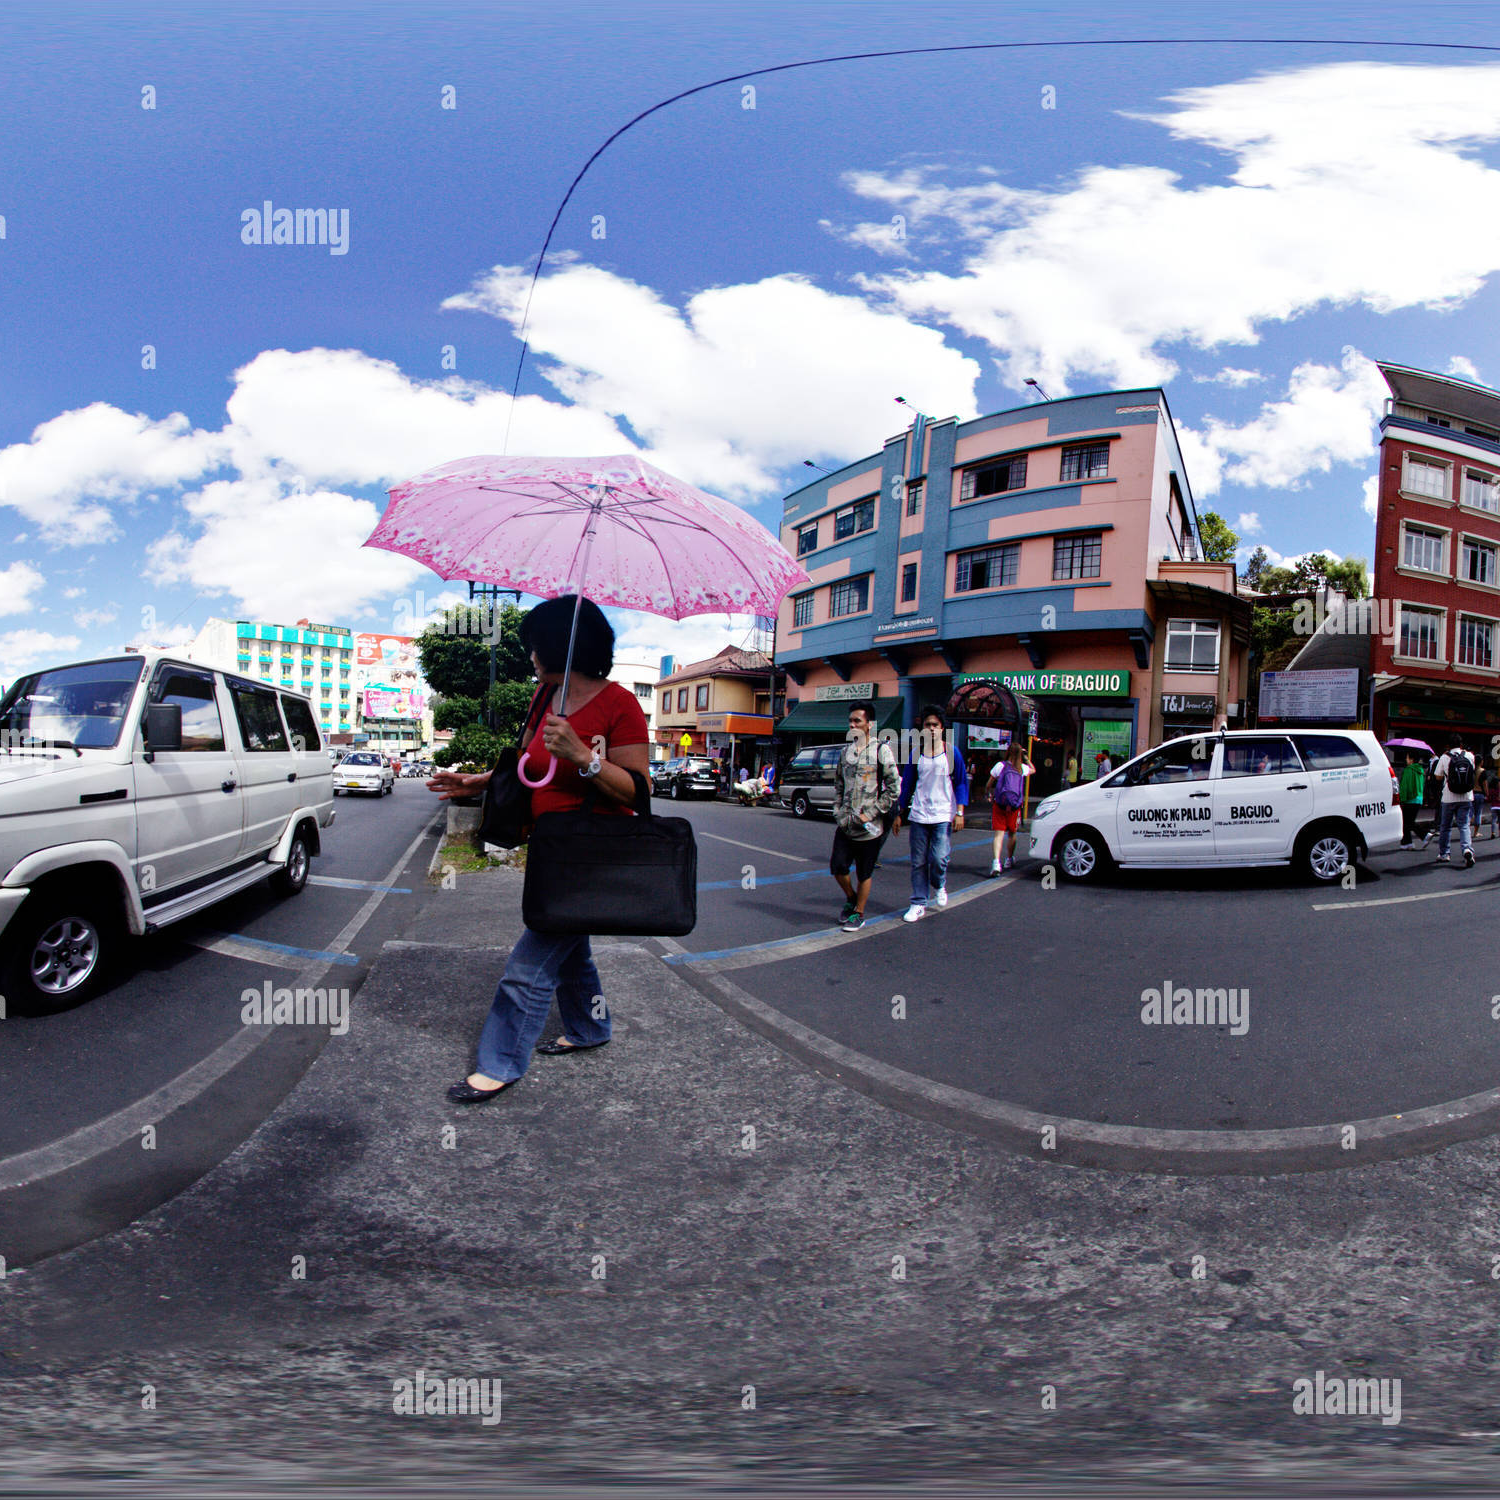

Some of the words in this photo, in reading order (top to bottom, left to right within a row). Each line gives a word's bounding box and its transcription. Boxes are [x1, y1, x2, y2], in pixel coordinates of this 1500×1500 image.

[1004, 675, 1035, 690] BANK
[1040, 675, 1056, 690] OF
[1065, 674, 1121, 692] BAGUIO
[1163, 695, 1185, 713] T&J
[1128, 808, 1168, 822] GULONG
[1170, 808, 1180, 821] NG
[1181, 807, 1211, 821] PALAD
[1230, 804, 1273, 820] BAGUIO
[1355, 801, 1386, 818] AYU-718
